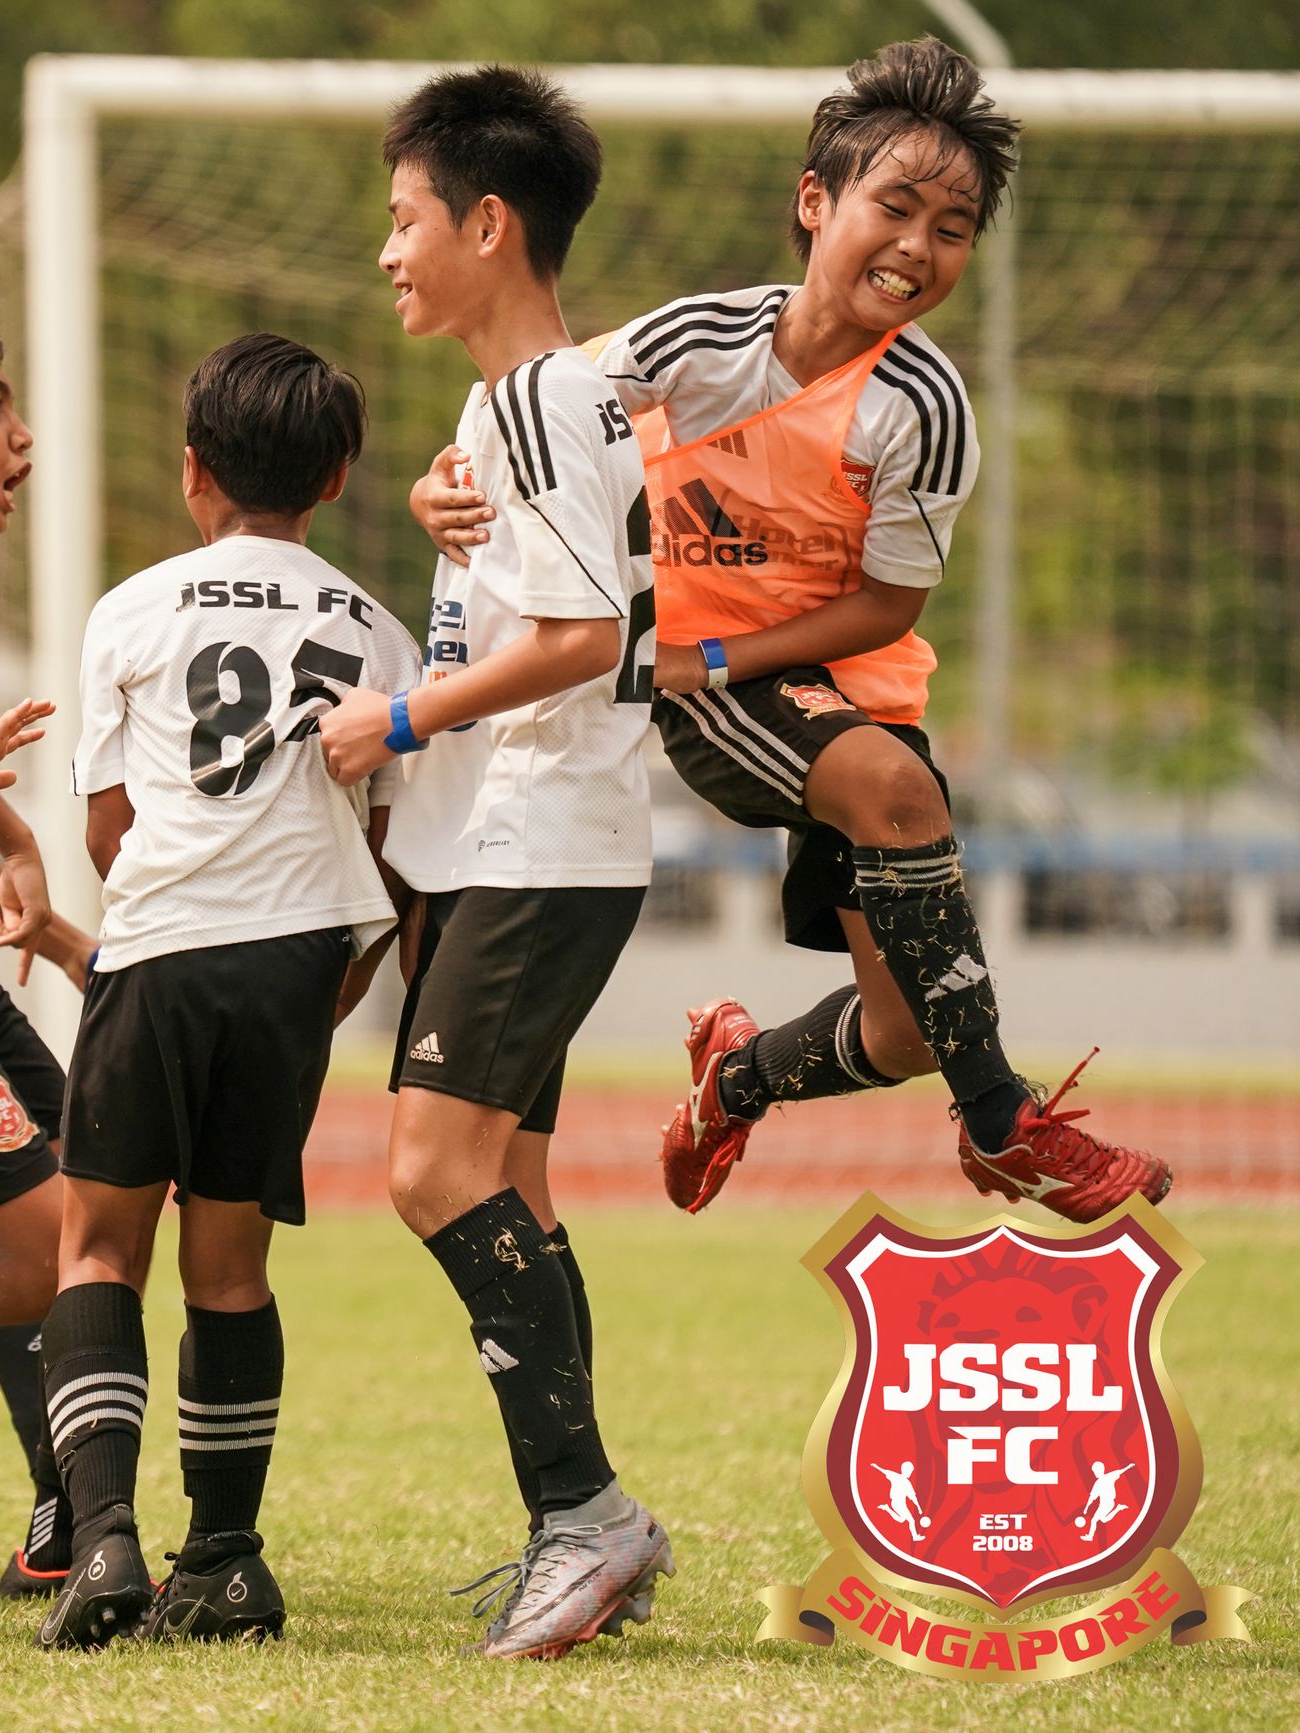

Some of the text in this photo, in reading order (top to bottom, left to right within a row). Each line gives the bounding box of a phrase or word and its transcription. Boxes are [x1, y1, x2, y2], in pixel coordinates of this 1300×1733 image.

[595, 397, 637, 446] JS
[175, 580, 373, 631] JSSL FC
[186, 638, 365, 797] 85
[410, 1049, 445, 1063] adidas
